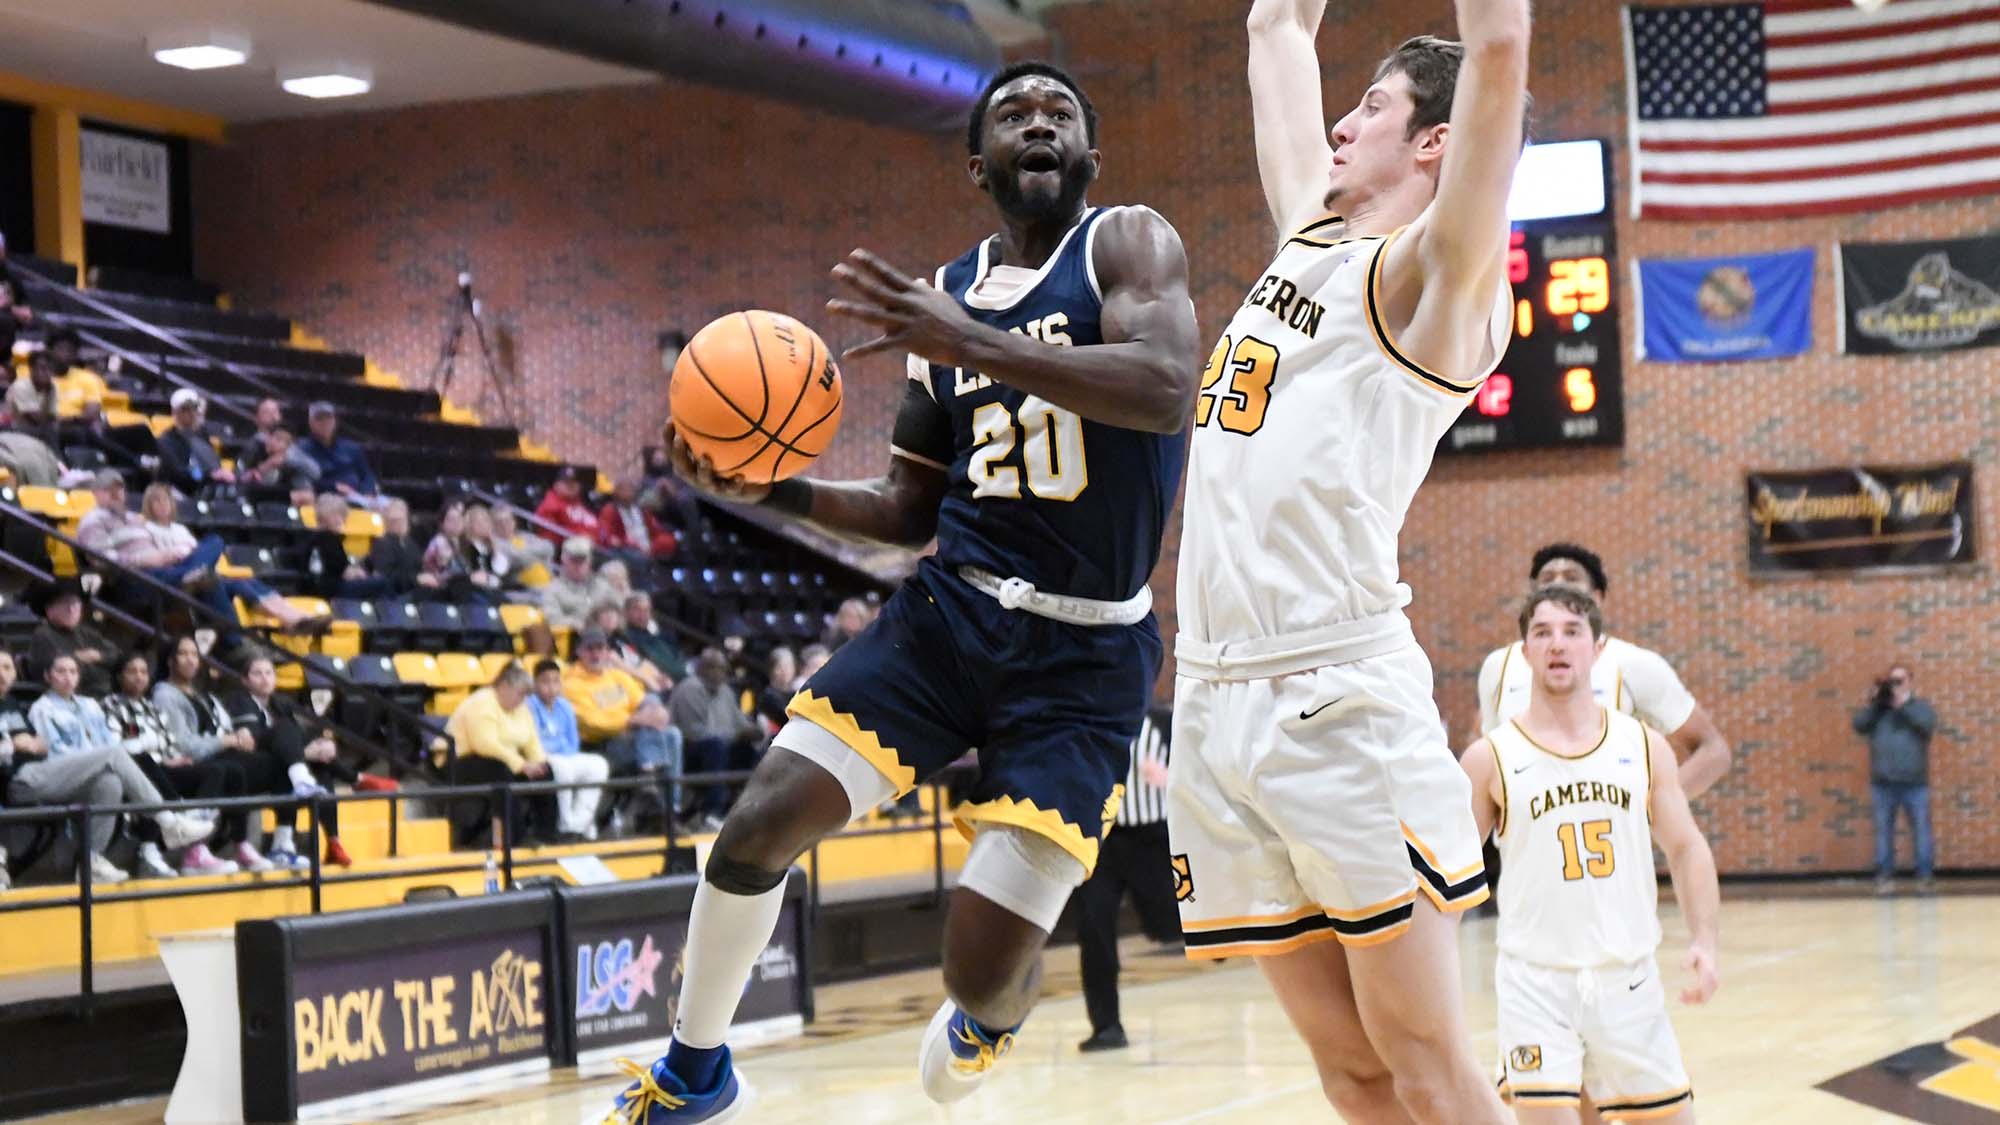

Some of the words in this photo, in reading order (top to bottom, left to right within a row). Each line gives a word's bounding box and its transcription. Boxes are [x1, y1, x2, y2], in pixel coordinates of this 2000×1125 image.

[1249, 274, 1326, 340] ERON
[1546, 257, 1609, 315] 29
[1195, 333, 1280, 437] 23
[1564, 368, 1596, 412] 5
[967, 393, 1088, 502] 20
[1530, 781, 1631, 820] CAMERON
[1557, 819, 1615, 881] 15
[576, 938, 633, 1018] LSC
[294, 987, 386, 1073] BACK
[394, 975, 458, 1051] THE
